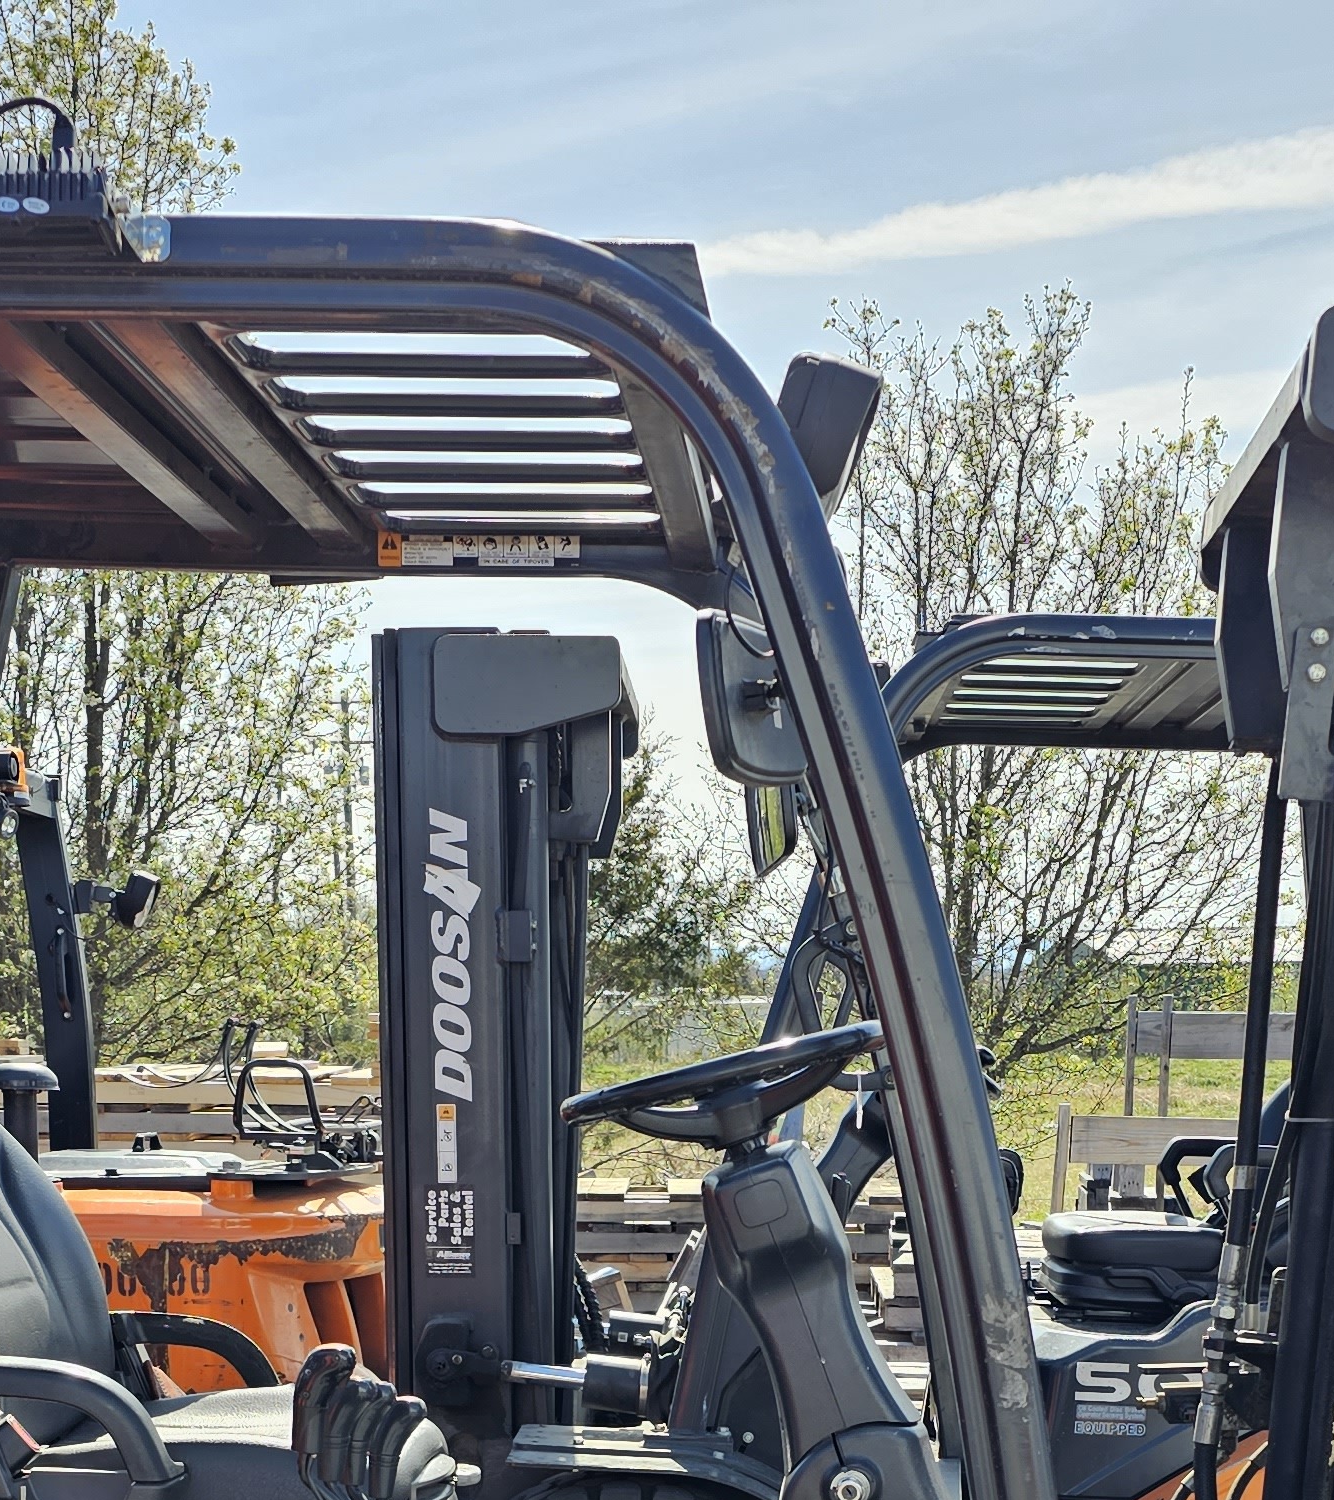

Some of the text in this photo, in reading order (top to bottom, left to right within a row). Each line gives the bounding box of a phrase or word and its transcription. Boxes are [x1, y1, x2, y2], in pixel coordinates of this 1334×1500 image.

[427, 807, 474, 1102] DOOSAN
[424, 1189, 437, 1243] Service
[438, 1189, 449, 1227] Parts
[449, 1190, 462, 1245] Sales &
[461, 1190, 474, 1236] Rental
[1074, 1420, 1146, 1437] EQUIPPED
